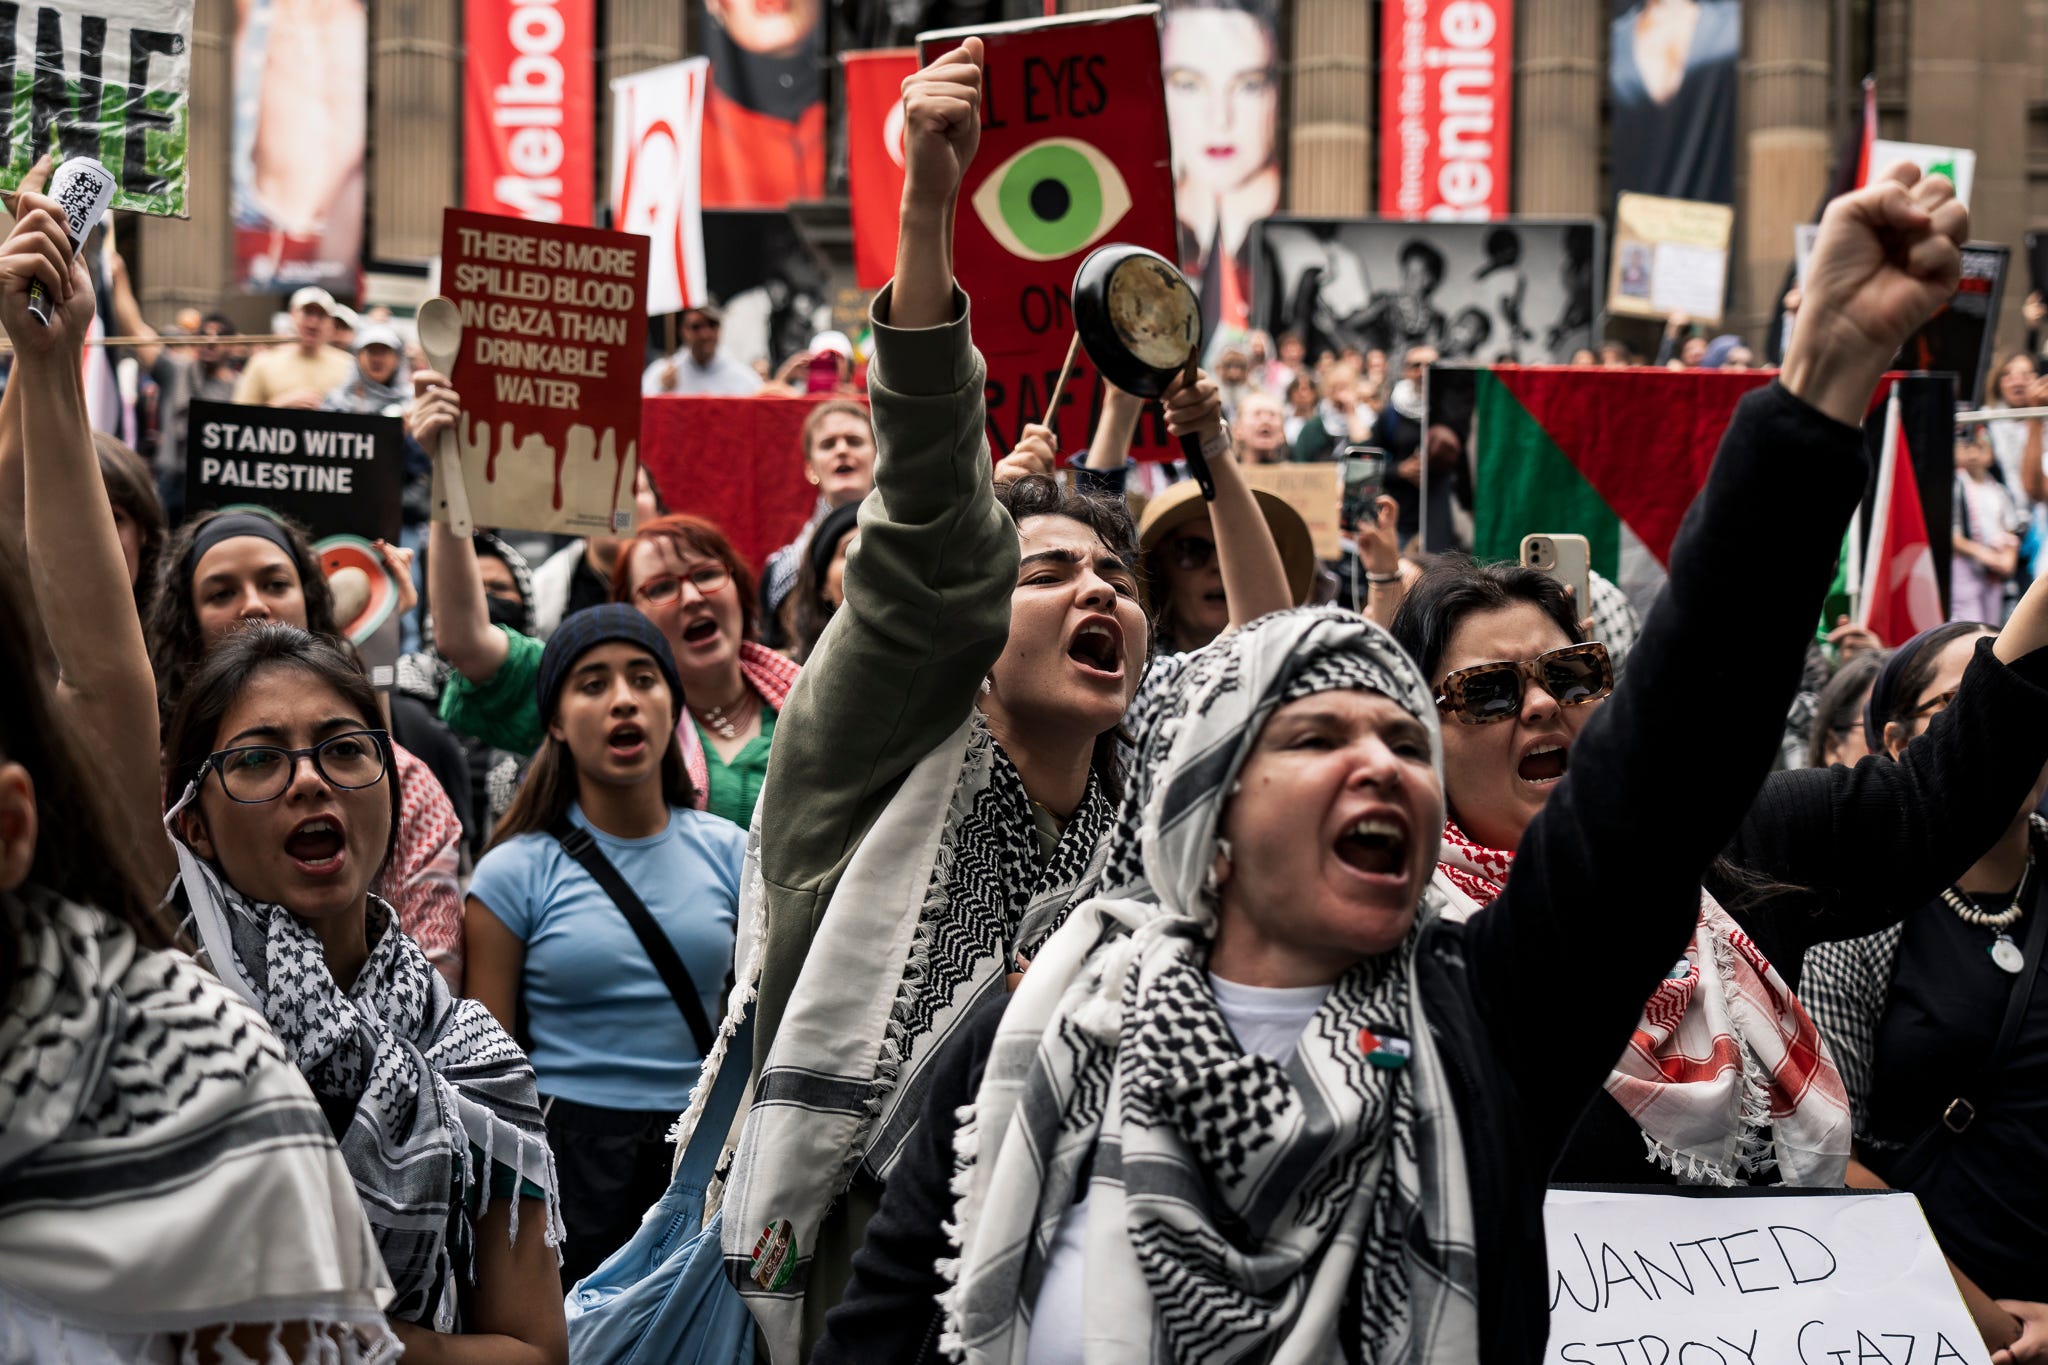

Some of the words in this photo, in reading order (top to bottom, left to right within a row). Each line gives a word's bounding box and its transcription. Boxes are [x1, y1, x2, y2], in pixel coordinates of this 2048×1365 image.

[494, 0, 565, 223] Melbo
[1023, 55, 1109, 124] EYES
[458, 228, 536, 266] THERE
[539, 239, 563, 268] IS
[565, 242, 637, 277] MORE
[454, 263, 550, 301] SPILLED
[553, 276, 635, 311] BLOOD
[460, 298, 486, 329] IN
[488, 304, 555, 338] GAZA
[558, 311, 627, 346] THAN
[475, 336, 609, 378] DRINKABLE
[494, 373, 580, 411] WATER
[202, 422, 297, 454] STAND
[302, 429, 375, 460] WITH
[201, 457, 353, 494] PALESTINE
[1550, 1226, 1837, 1312] WANTED
